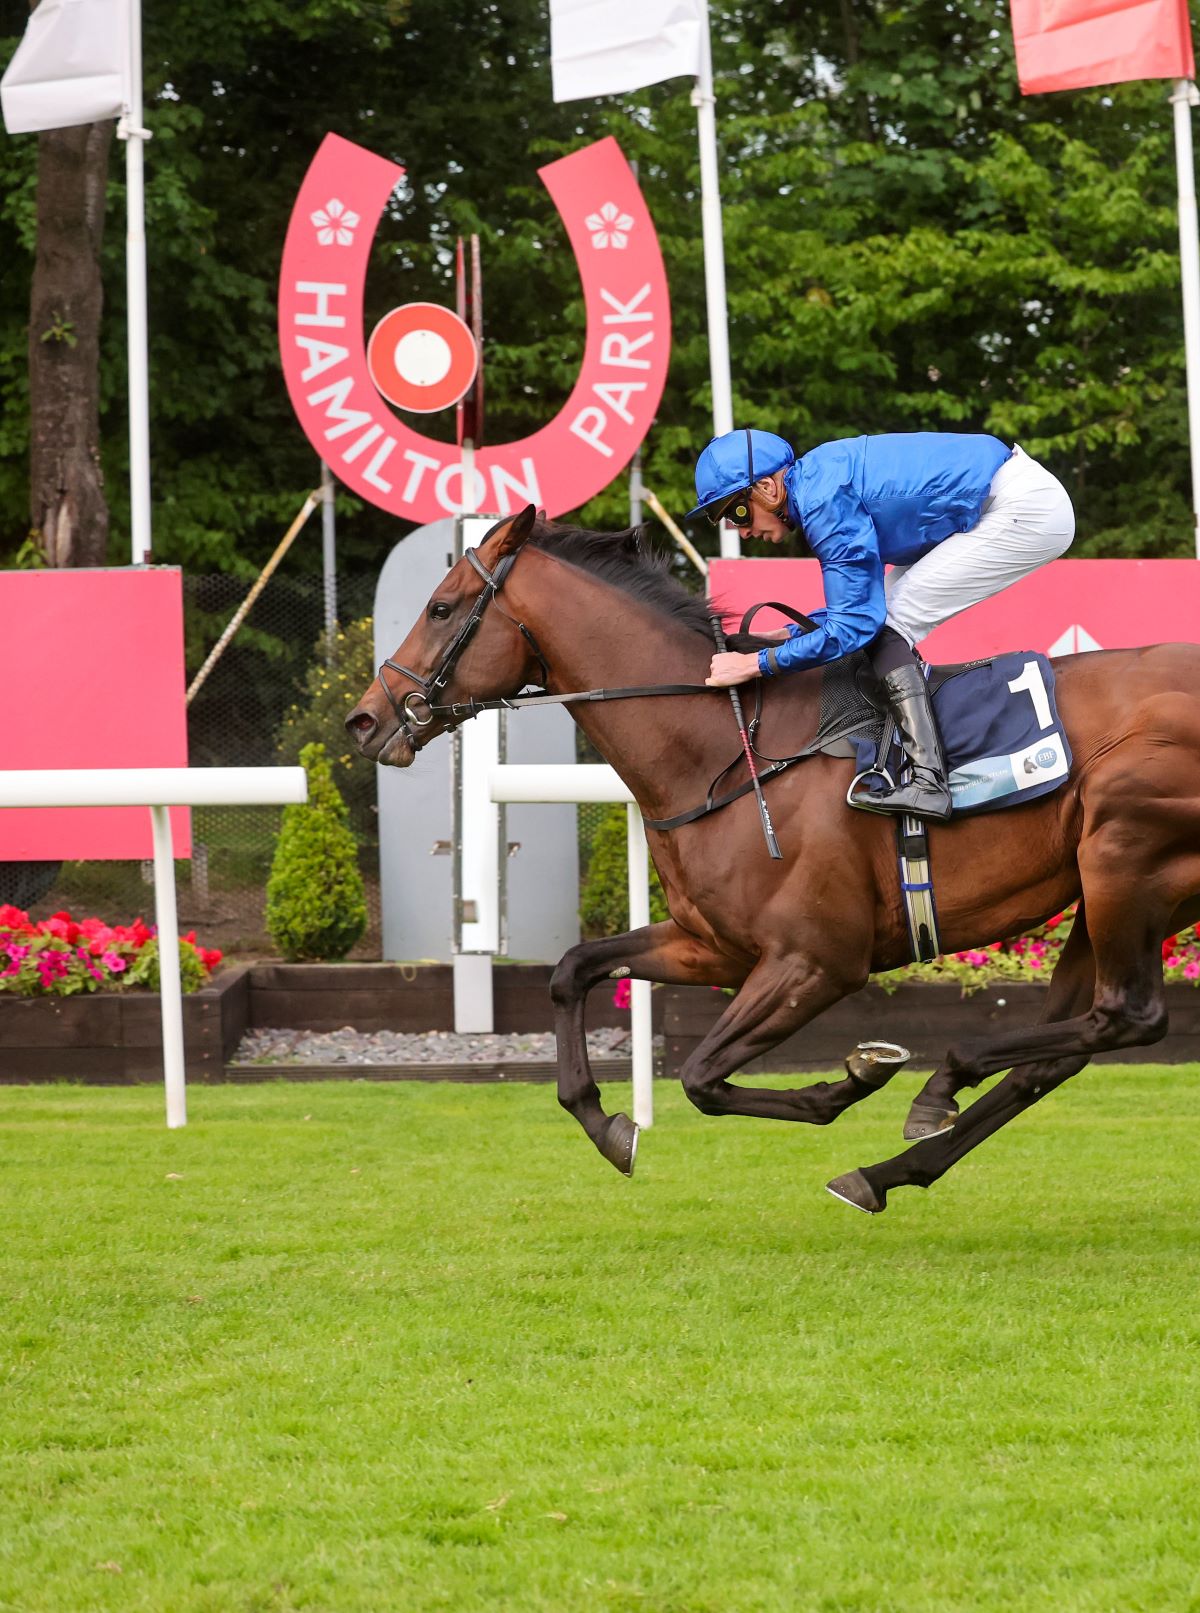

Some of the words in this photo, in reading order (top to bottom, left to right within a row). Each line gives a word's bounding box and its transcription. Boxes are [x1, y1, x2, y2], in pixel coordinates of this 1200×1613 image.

[294, 281, 543, 514] HAMILTON
[569, 283, 655, 459] PARK
[1008, 660, 1054, 731] 1
[1038, 750, 1055, 762] EBF
